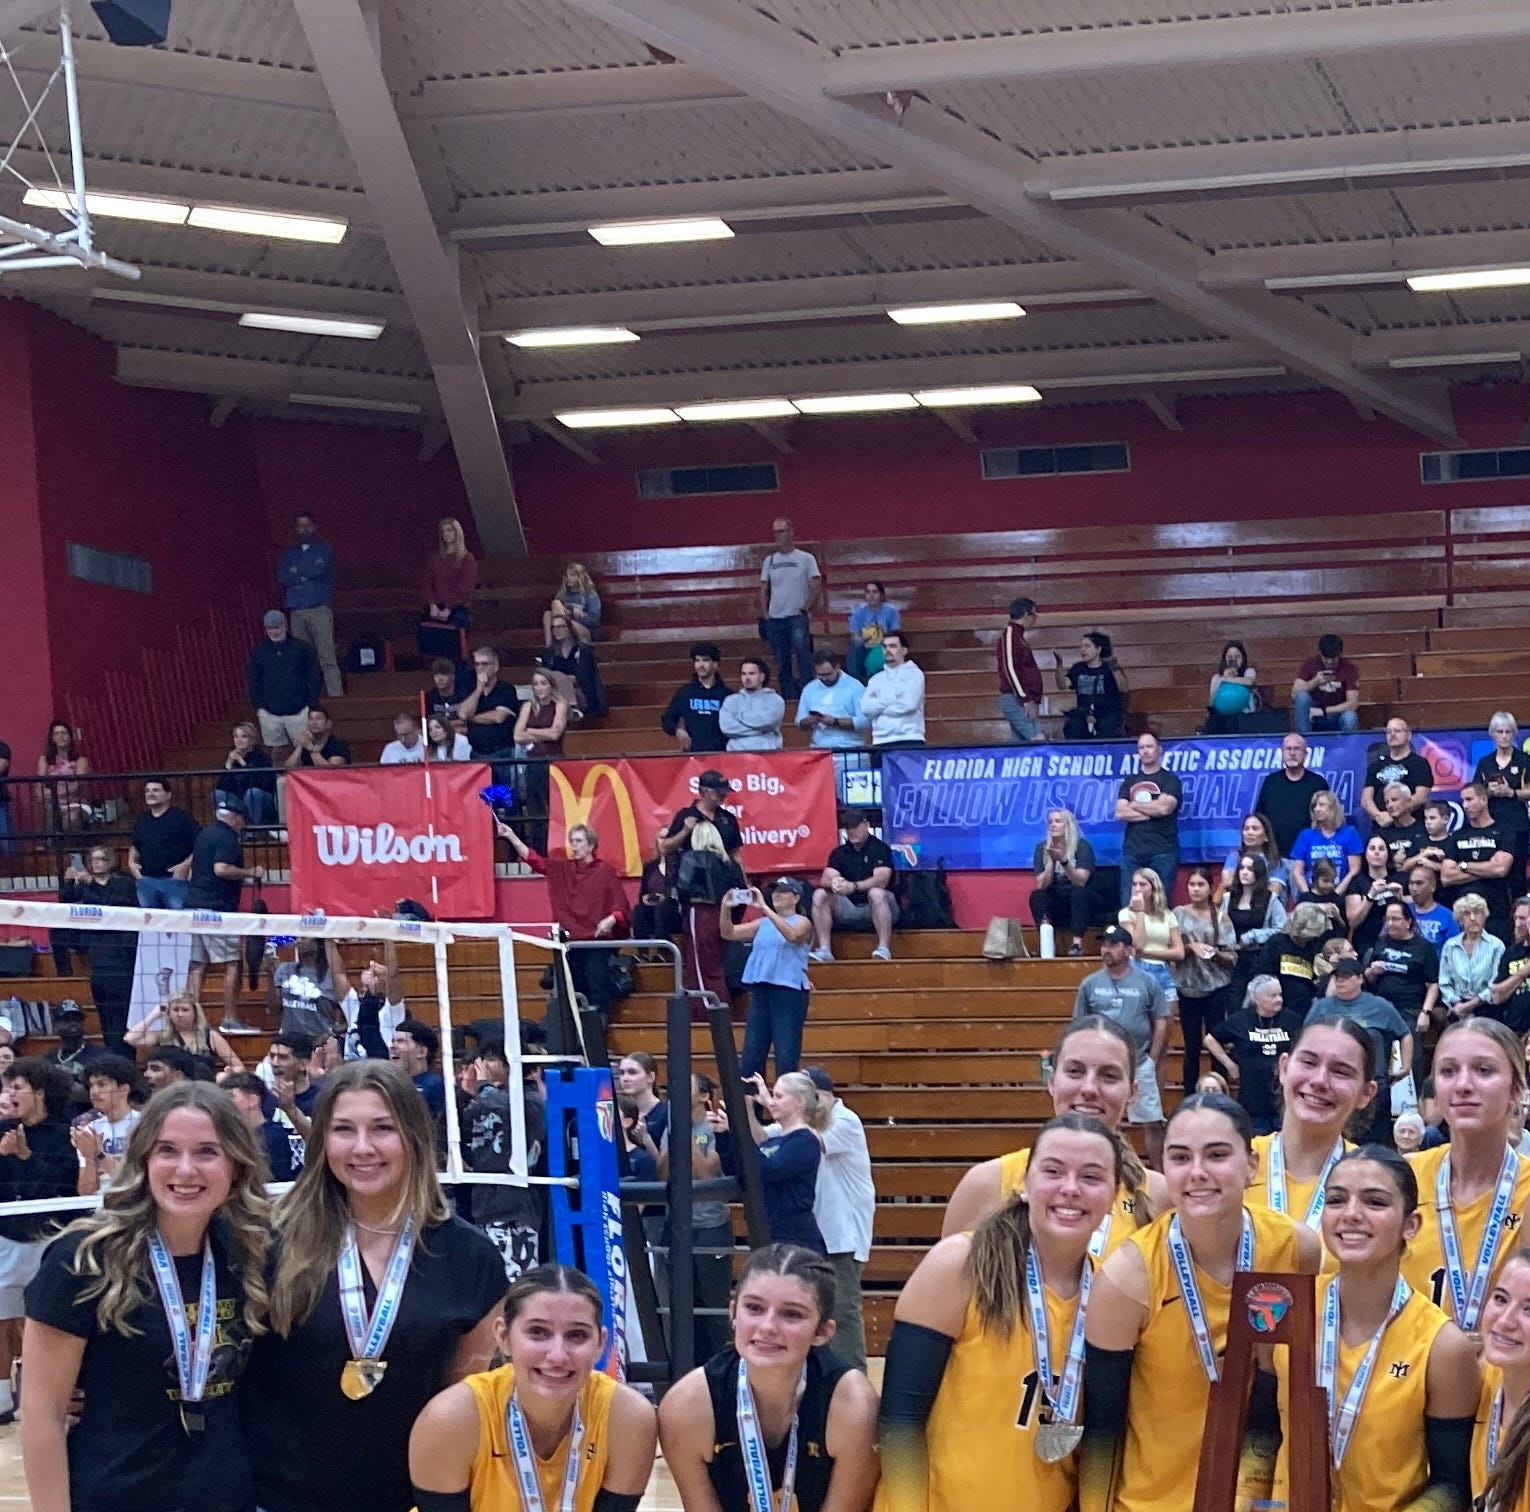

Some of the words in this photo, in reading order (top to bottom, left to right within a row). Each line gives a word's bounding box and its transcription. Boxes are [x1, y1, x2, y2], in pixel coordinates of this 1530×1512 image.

[747, 773, 785, 795] Big,
[924, 758, 996, 780] FLORIDA
[1002, 756, 1044, 779] HIGH
[1047, 753, 1114, 776] SCHOOL
[1120, 750, 1200, 776] ATETIC
[1205, 746, 1325, 770] ASSOCIAON
[893, 780, 1022, 828] FOLLOW
[1023, 779, 1071, 826] US
[312, 822, 463, 866] Wilson
[1481, 1193, 1506, 1264] VOLLEYBALL
[1173, 1243, 1200, 1320] VOLLEYBALL
